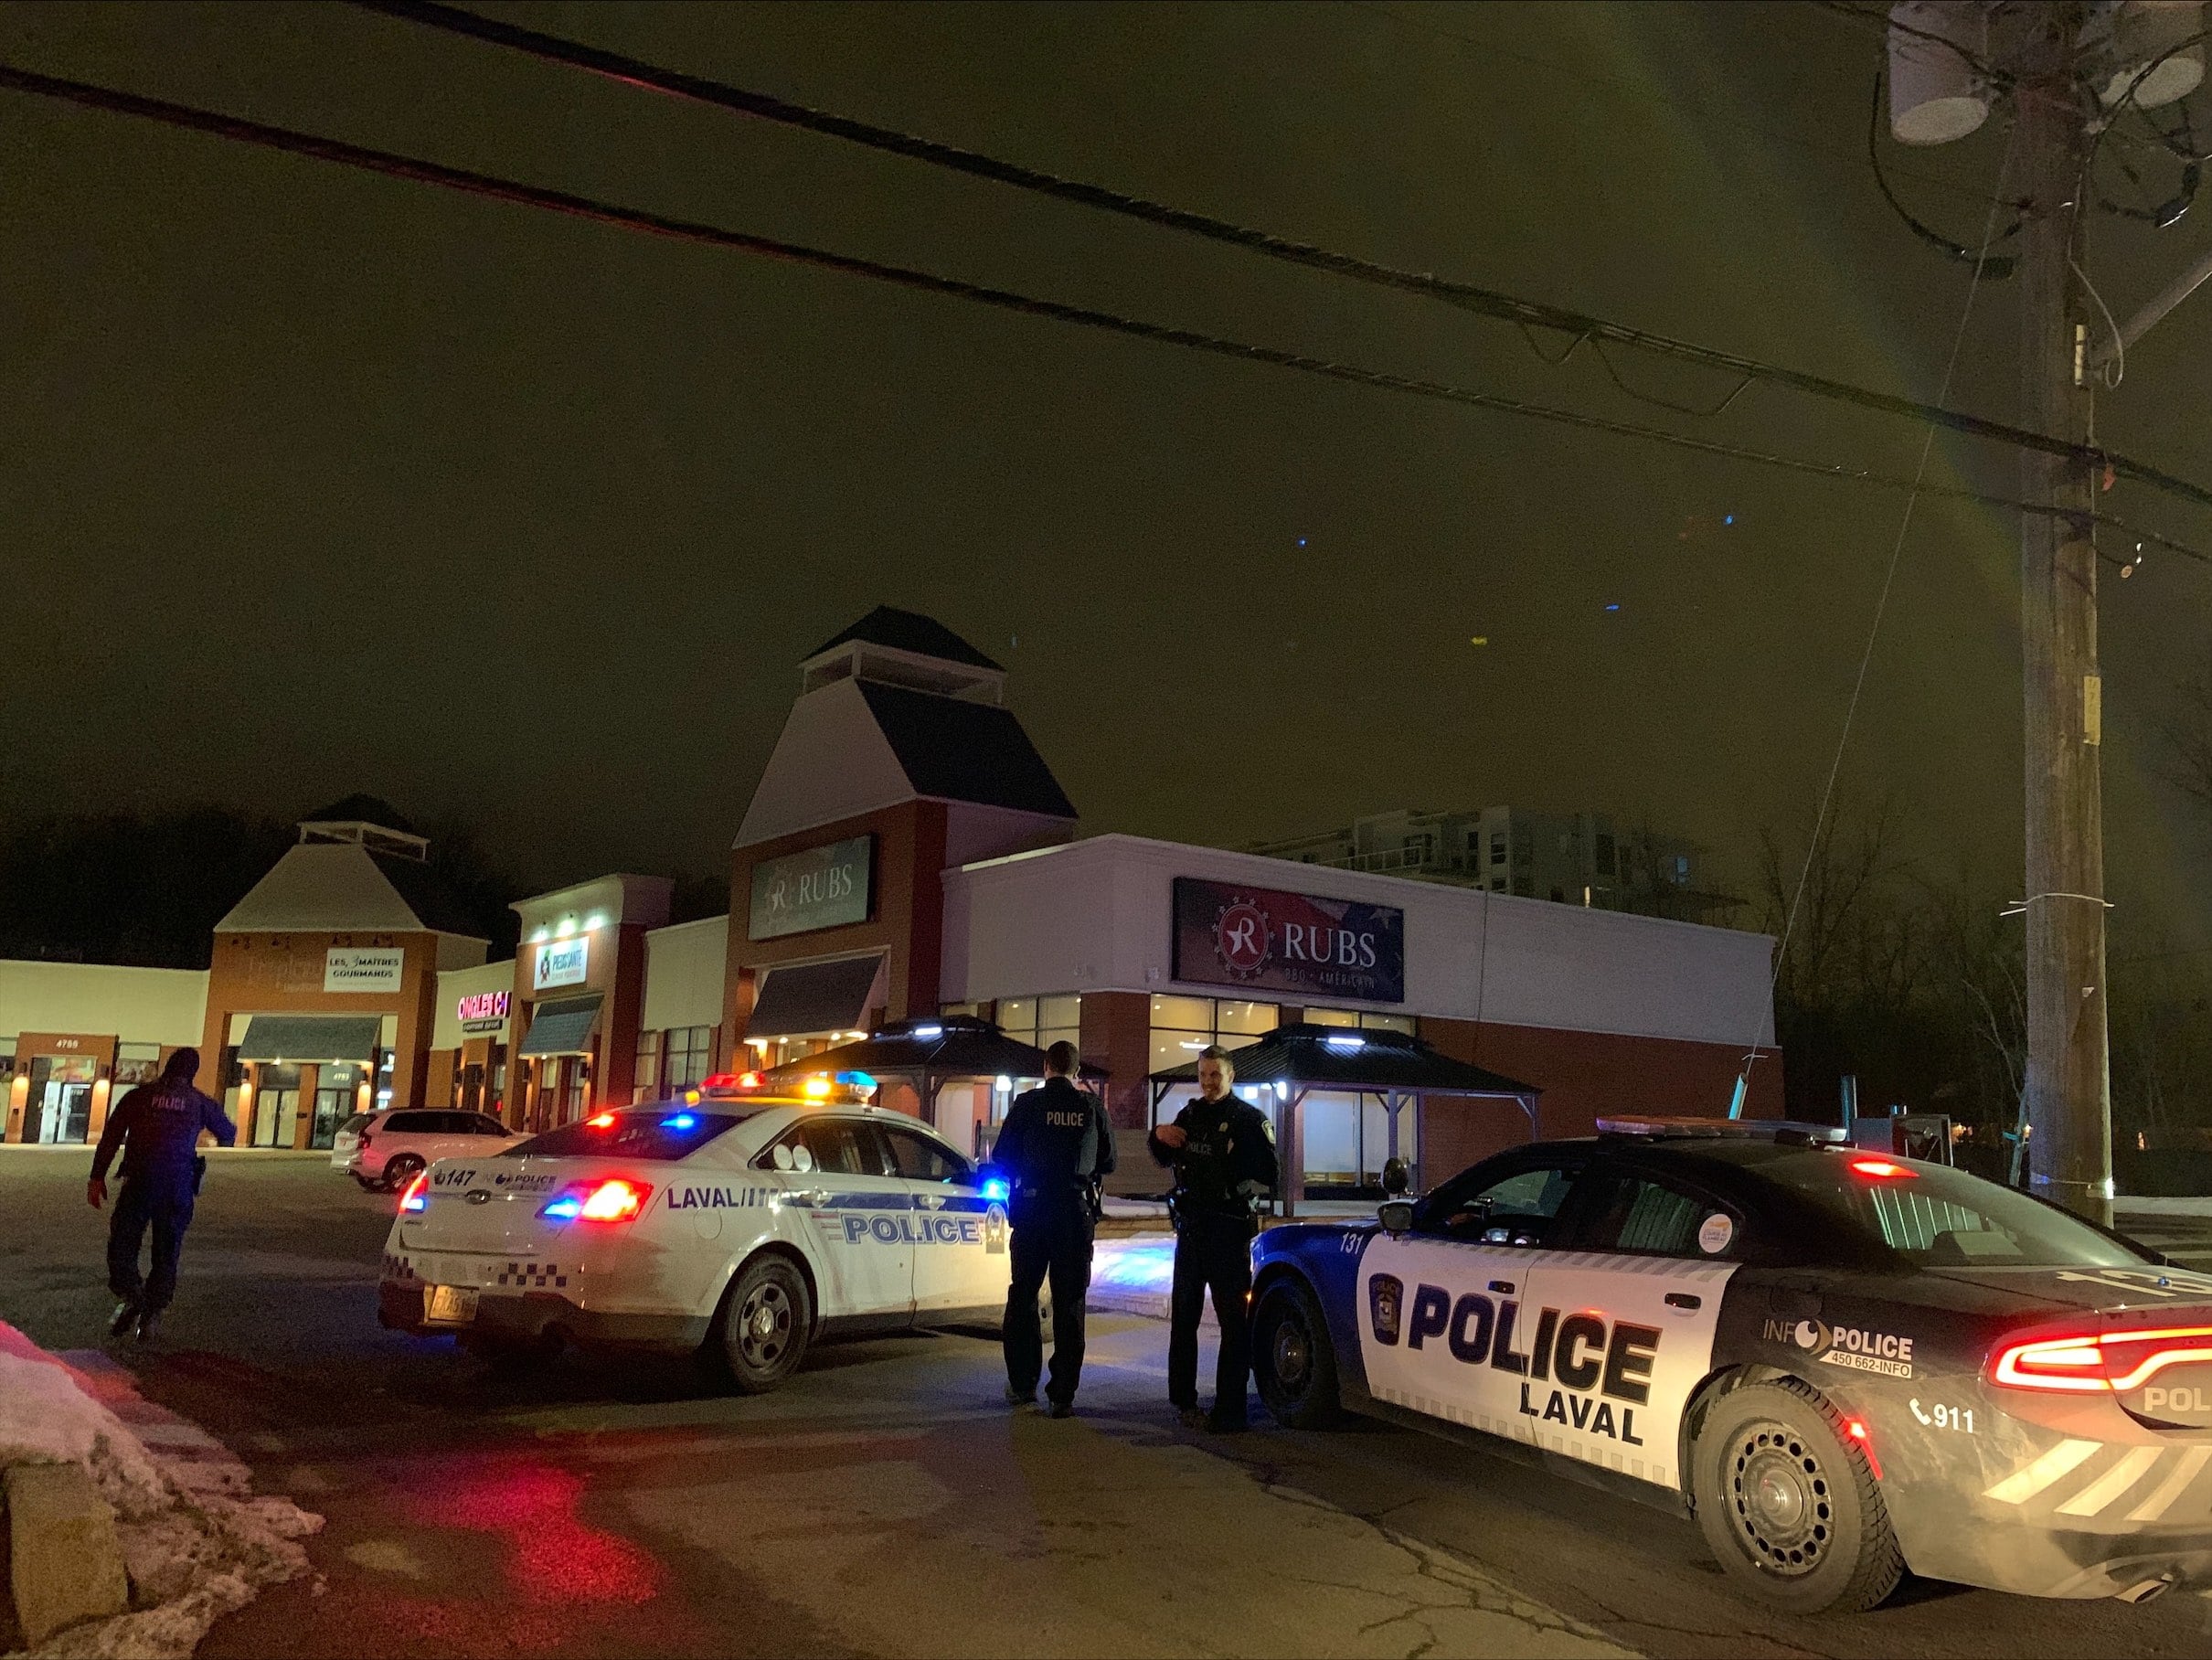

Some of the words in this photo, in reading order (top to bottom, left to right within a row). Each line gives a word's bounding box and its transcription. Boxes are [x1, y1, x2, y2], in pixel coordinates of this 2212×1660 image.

[799, 863, 854, 905] RUBS
[1282, 921, 1377, 968] RUBS
[333, 970, 394, 979] GOURMANDS
[1284, 967, 1305, 983] BBQ
[457, 992, 495, 1021] ONGLES
[152, 1095, 186, 1112] POLICE
[1047, 1111, 1084, 1127] POLICE
[446, 1169, 477, 1186] 147
[515, 1174, 558, 1185] POLICE
[667, 1186, 741, 1209] LAVAL
[841, 1213, 984, 1246] POLICE
[1340, 1232, 1364, 1255] 131
[1408, 1283, 1664, 1406] POLICE
[1832, 1325, 1913, 1361] POLICE
[1832, 1352, 1852, 1366] 450
[1855, 1355, 1910, 1377] 662-INFO
[2144, 1387, 2212, 1411] POL
[1519, 1382, 1643, 1446] LAVAL
[1932, 1403, 1973, 1433] 911
